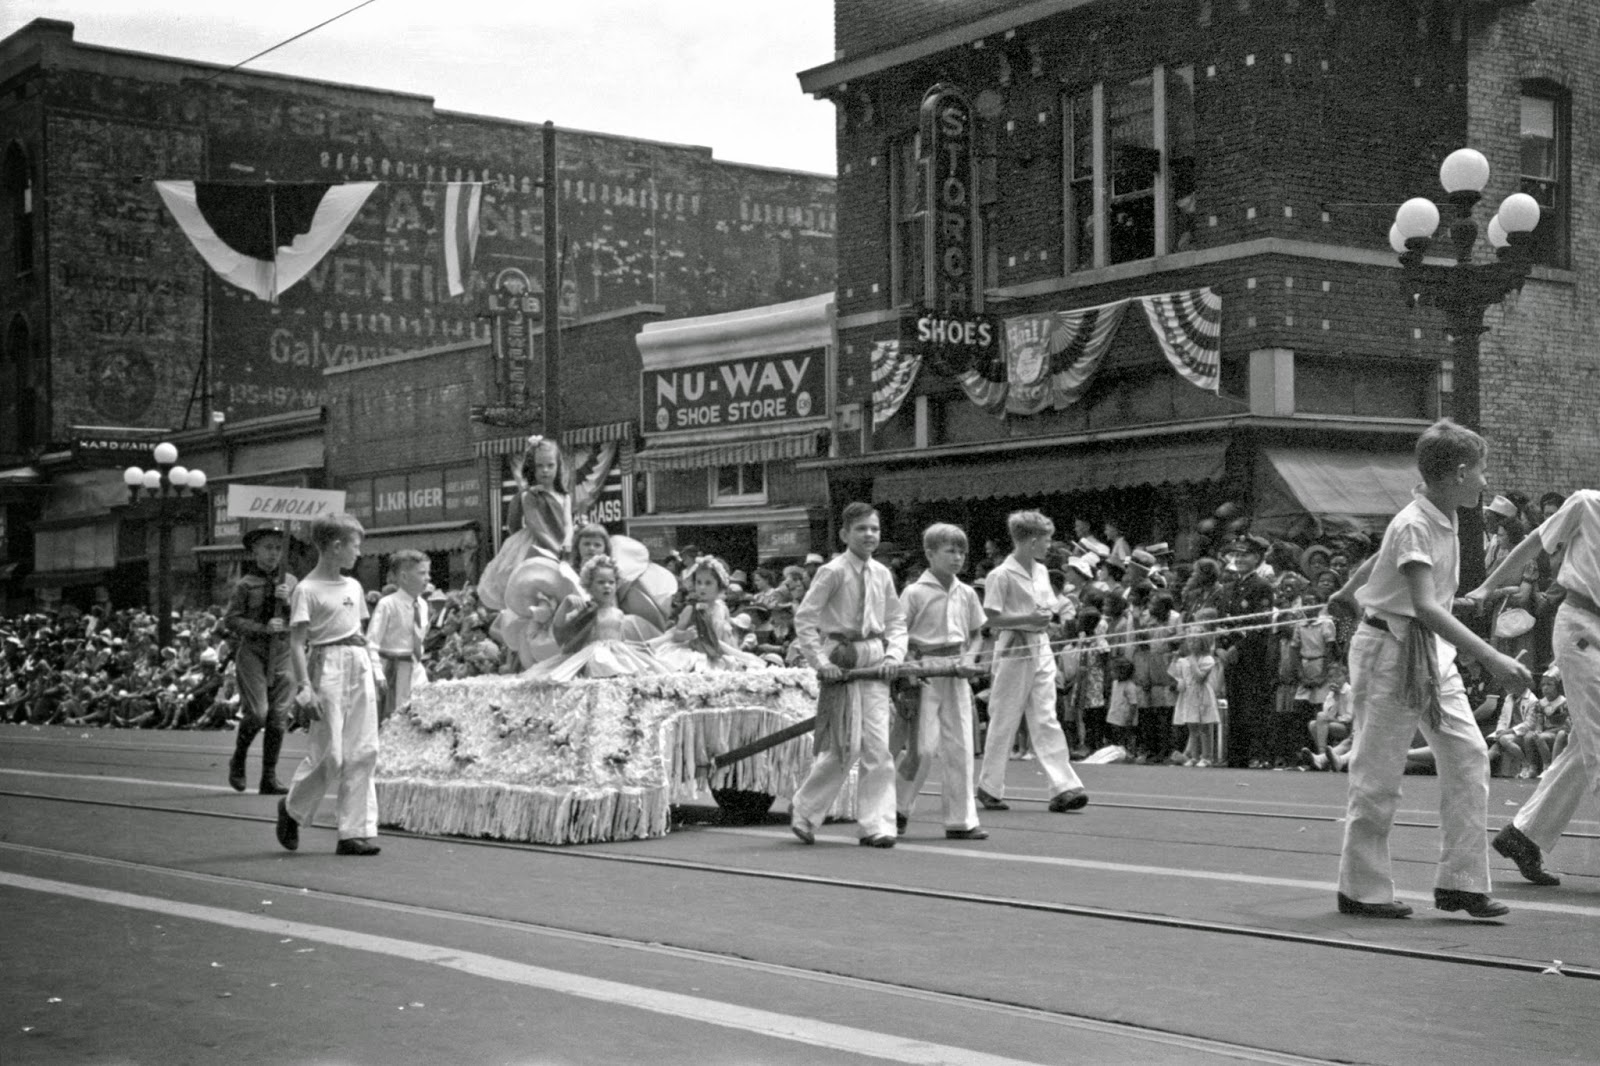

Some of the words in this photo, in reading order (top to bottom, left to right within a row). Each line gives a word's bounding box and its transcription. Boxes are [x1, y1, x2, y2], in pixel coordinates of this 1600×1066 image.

[942, 107, 967, 312] STORCH
[917, 316, 992, 347] SHOES
[656, 356, 812, 407] NU-WAY
[676, 404, 722, 427] SHOE
[727, 396, 788, 422] STORE
[249, 496, 328, 516] DEMOLAY
[771, 532, 797, 547] SHOE
